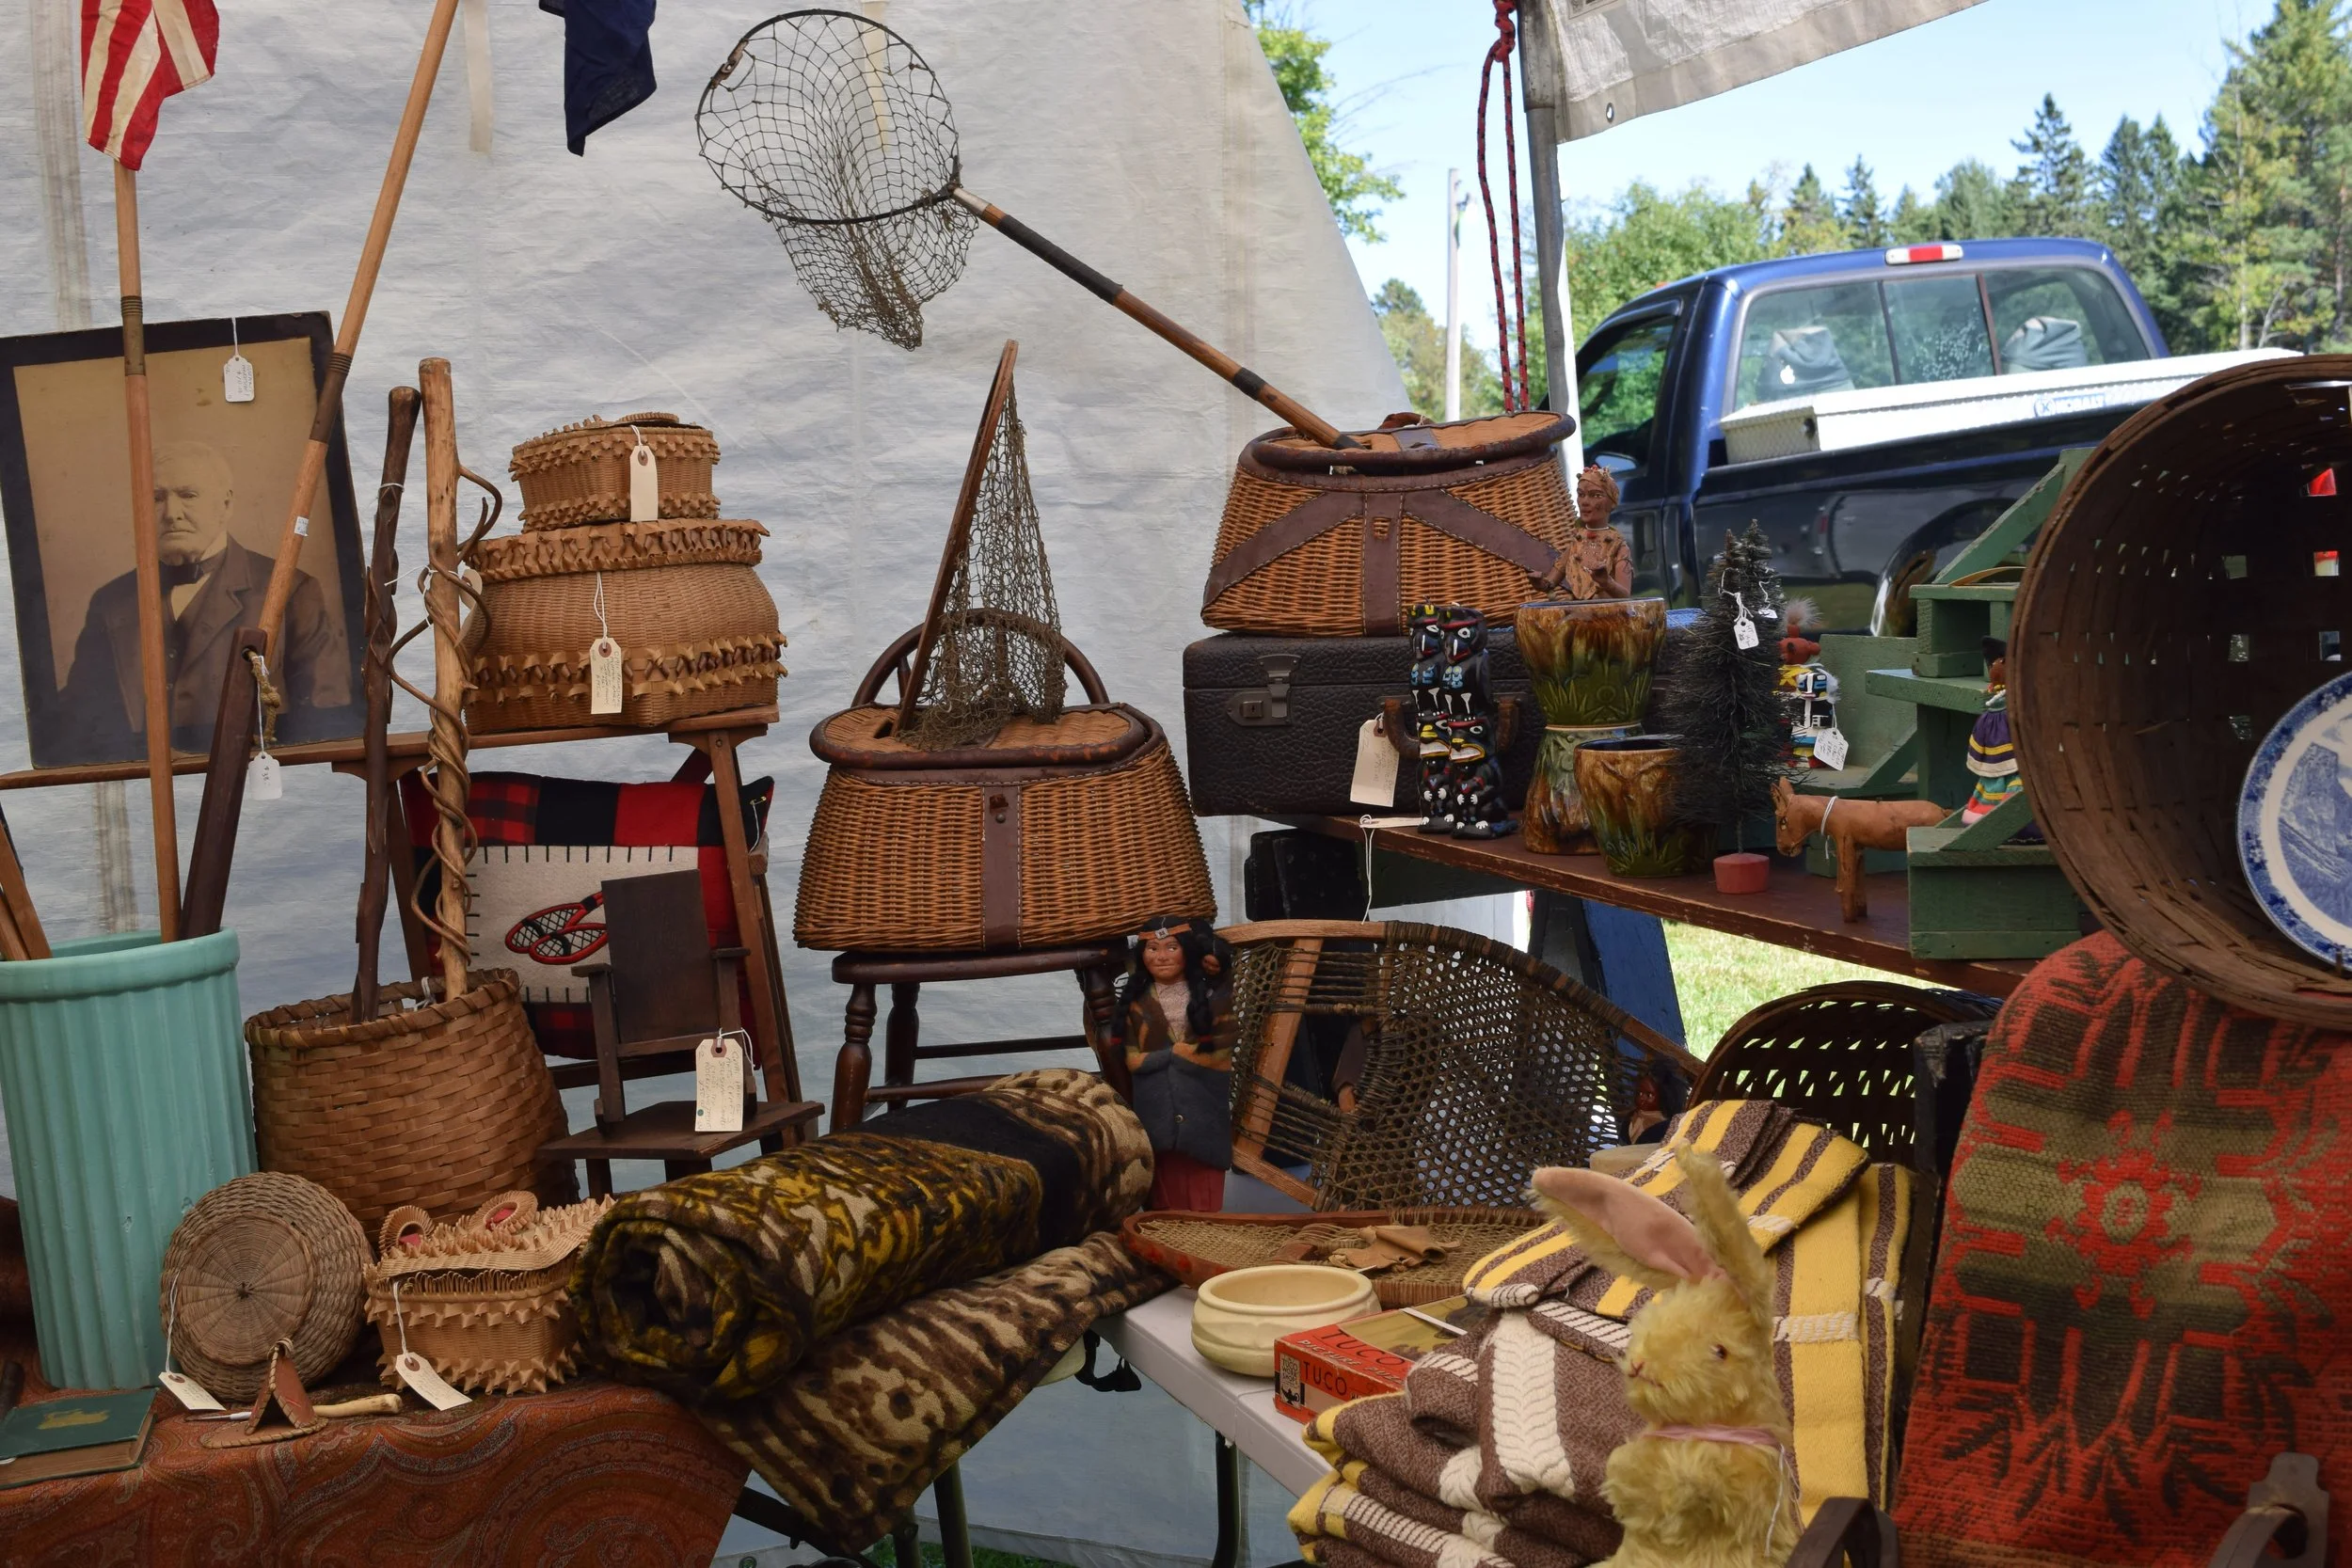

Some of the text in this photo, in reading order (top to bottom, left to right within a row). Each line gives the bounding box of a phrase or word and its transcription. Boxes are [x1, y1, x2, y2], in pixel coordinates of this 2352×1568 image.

[1297, 1339, 1361, 1366] PICTURE
[1321, 1328, 1406, 1366] TUCO
[1303, 1361, 1347, 1396] TUCO
